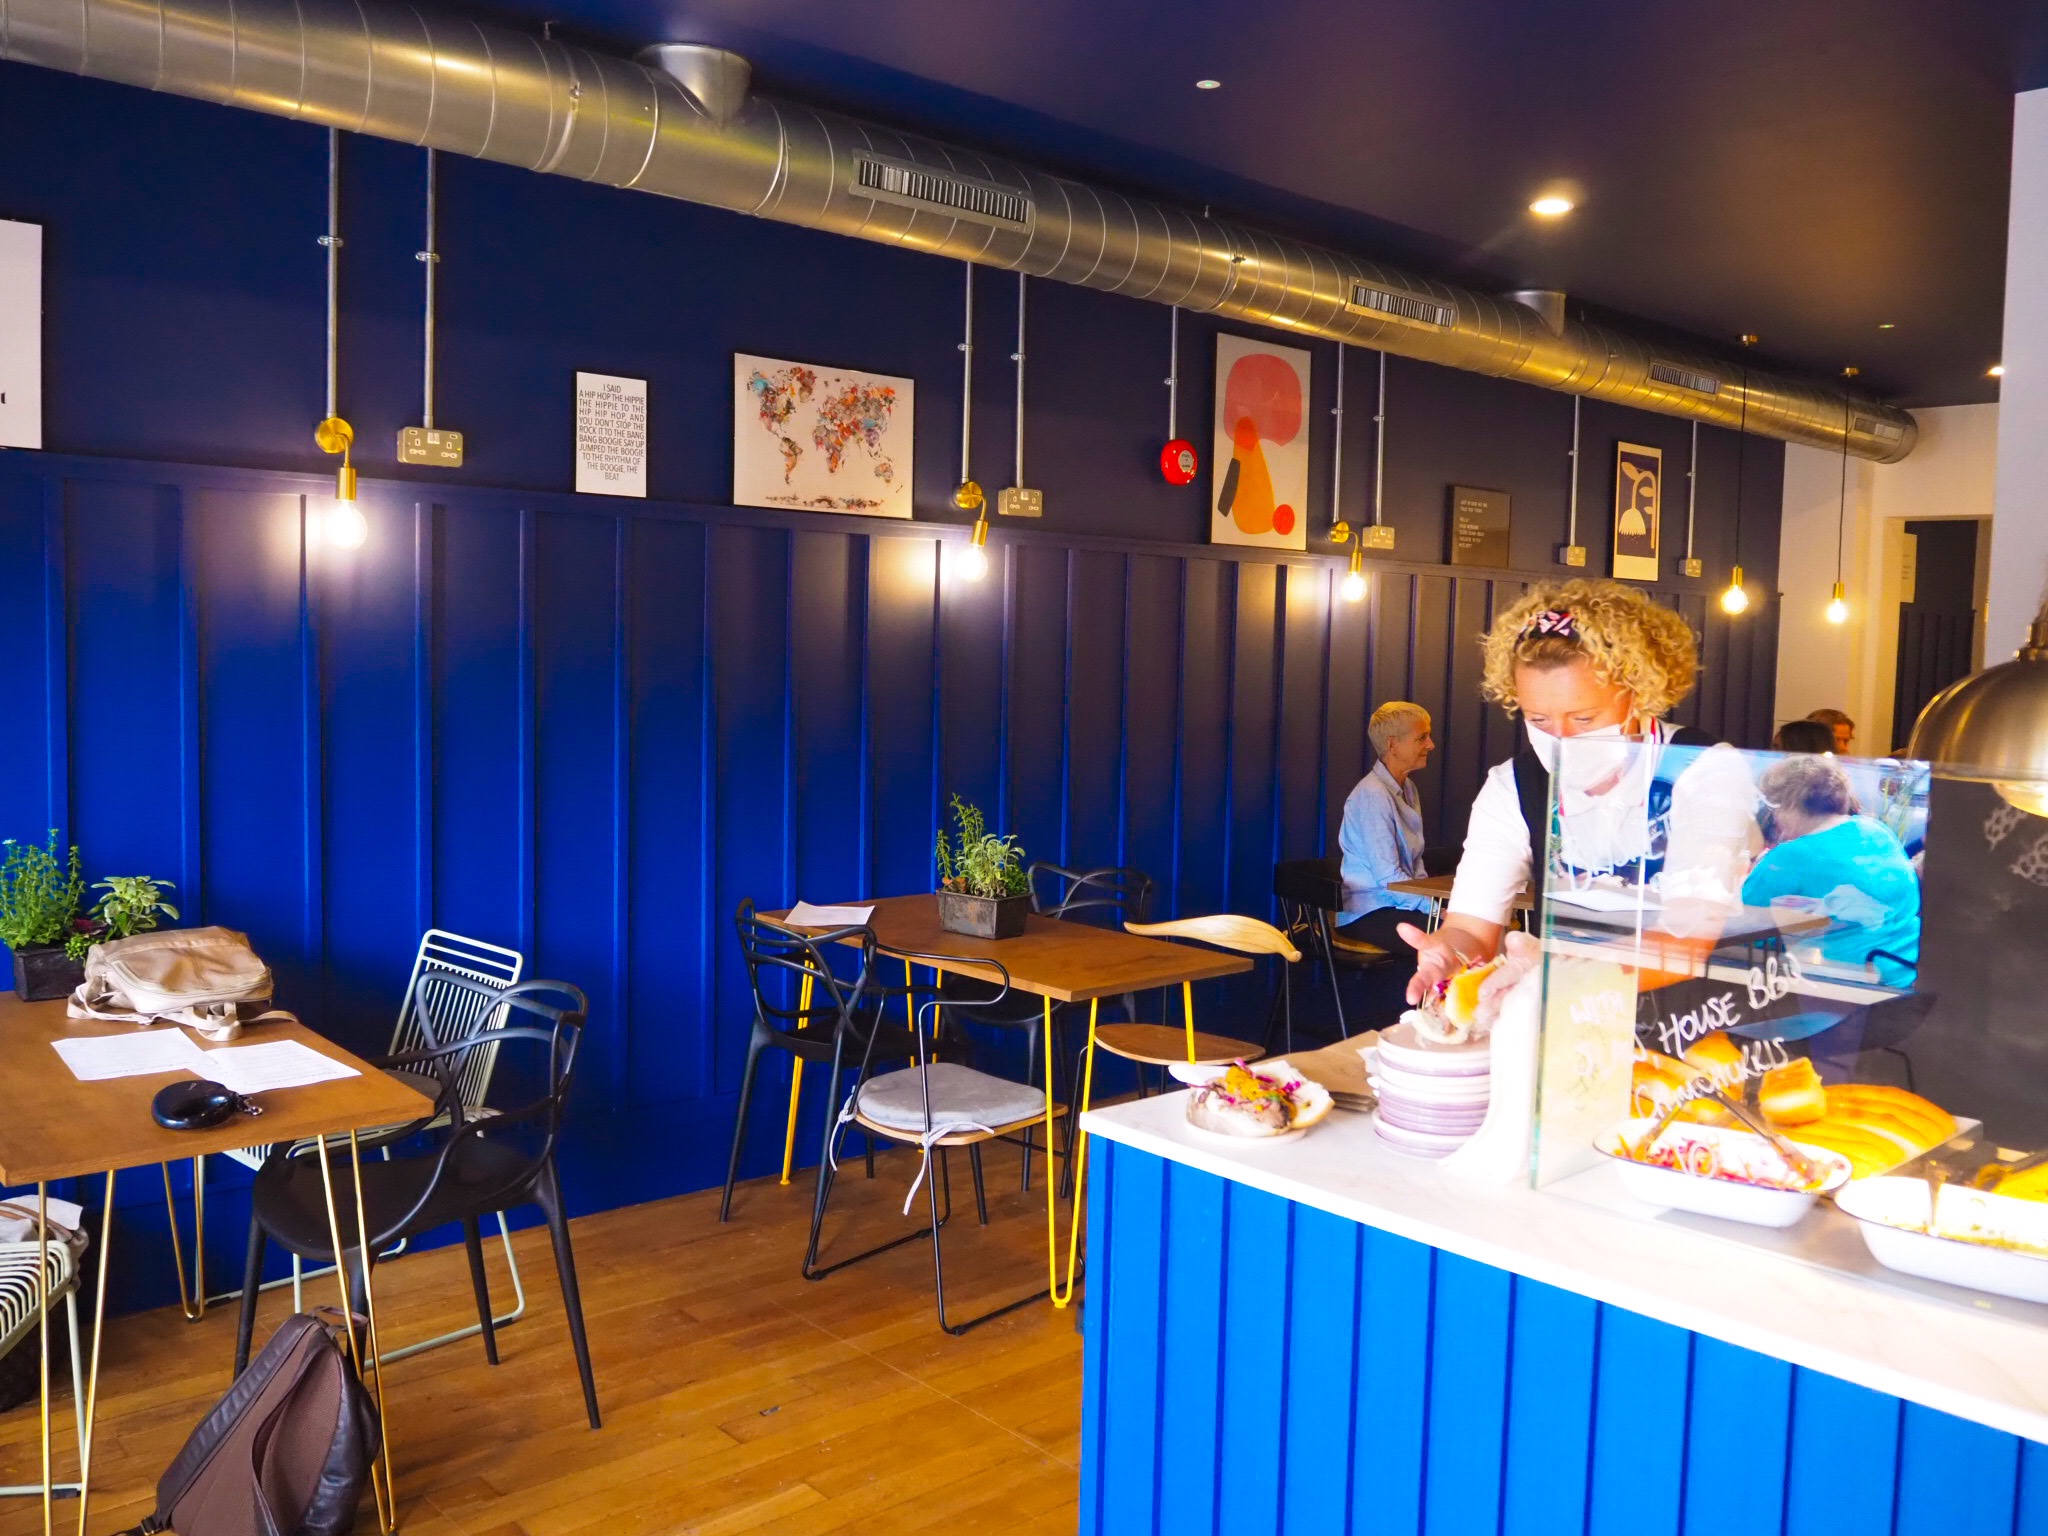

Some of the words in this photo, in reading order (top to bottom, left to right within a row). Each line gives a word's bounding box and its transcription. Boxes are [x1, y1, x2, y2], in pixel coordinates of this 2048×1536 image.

[606, 384, 622, 393] SAID
[585, 390, 596, 398] HIP
[597, 392, 611, 400] HOP
[612, 394, 623, 402] THE
[625, 396, 644, 405] HIPPIE
[579, 399, 592, 407] THE
[596, 401, 618, 410] HIPPIE
[621, 404, 629, 412] TO
[632, 405, 644, 413] THE
[579, 416, 592, 425] YOU
[616, 420, 631, 429] STOP
[633, 423, 644, 431] THE
[630, 414, 644, 422] AND
[579, 426, 596, 435] ROCK
[605, 428, 612, 436] TO
[614, 429, 625, 438] THE
[627, 431, 644, 439] BANG
[579, 435, 597, 444] BANG
[598, 437, 622, 446] BOOGIE
[624, 439, 635, 447] SAY
[579, 443, 605, 453] JUMPED
[607, 446, 618, 454] THE
[583, 452, 590, 460] TO
[592, 453, 603, 462] THE
[605, 455, 631, 464] RHYTHM
[632, 457, 640, 465] OF
[587, 462, 599, 470] THE
[626, 466, 638, 474] THE
[605, 472, 620, 480] BEAT
[1657, 992, 1741, 1061] HOUSE
[1746, 952, 1818, 1010] BBQ
